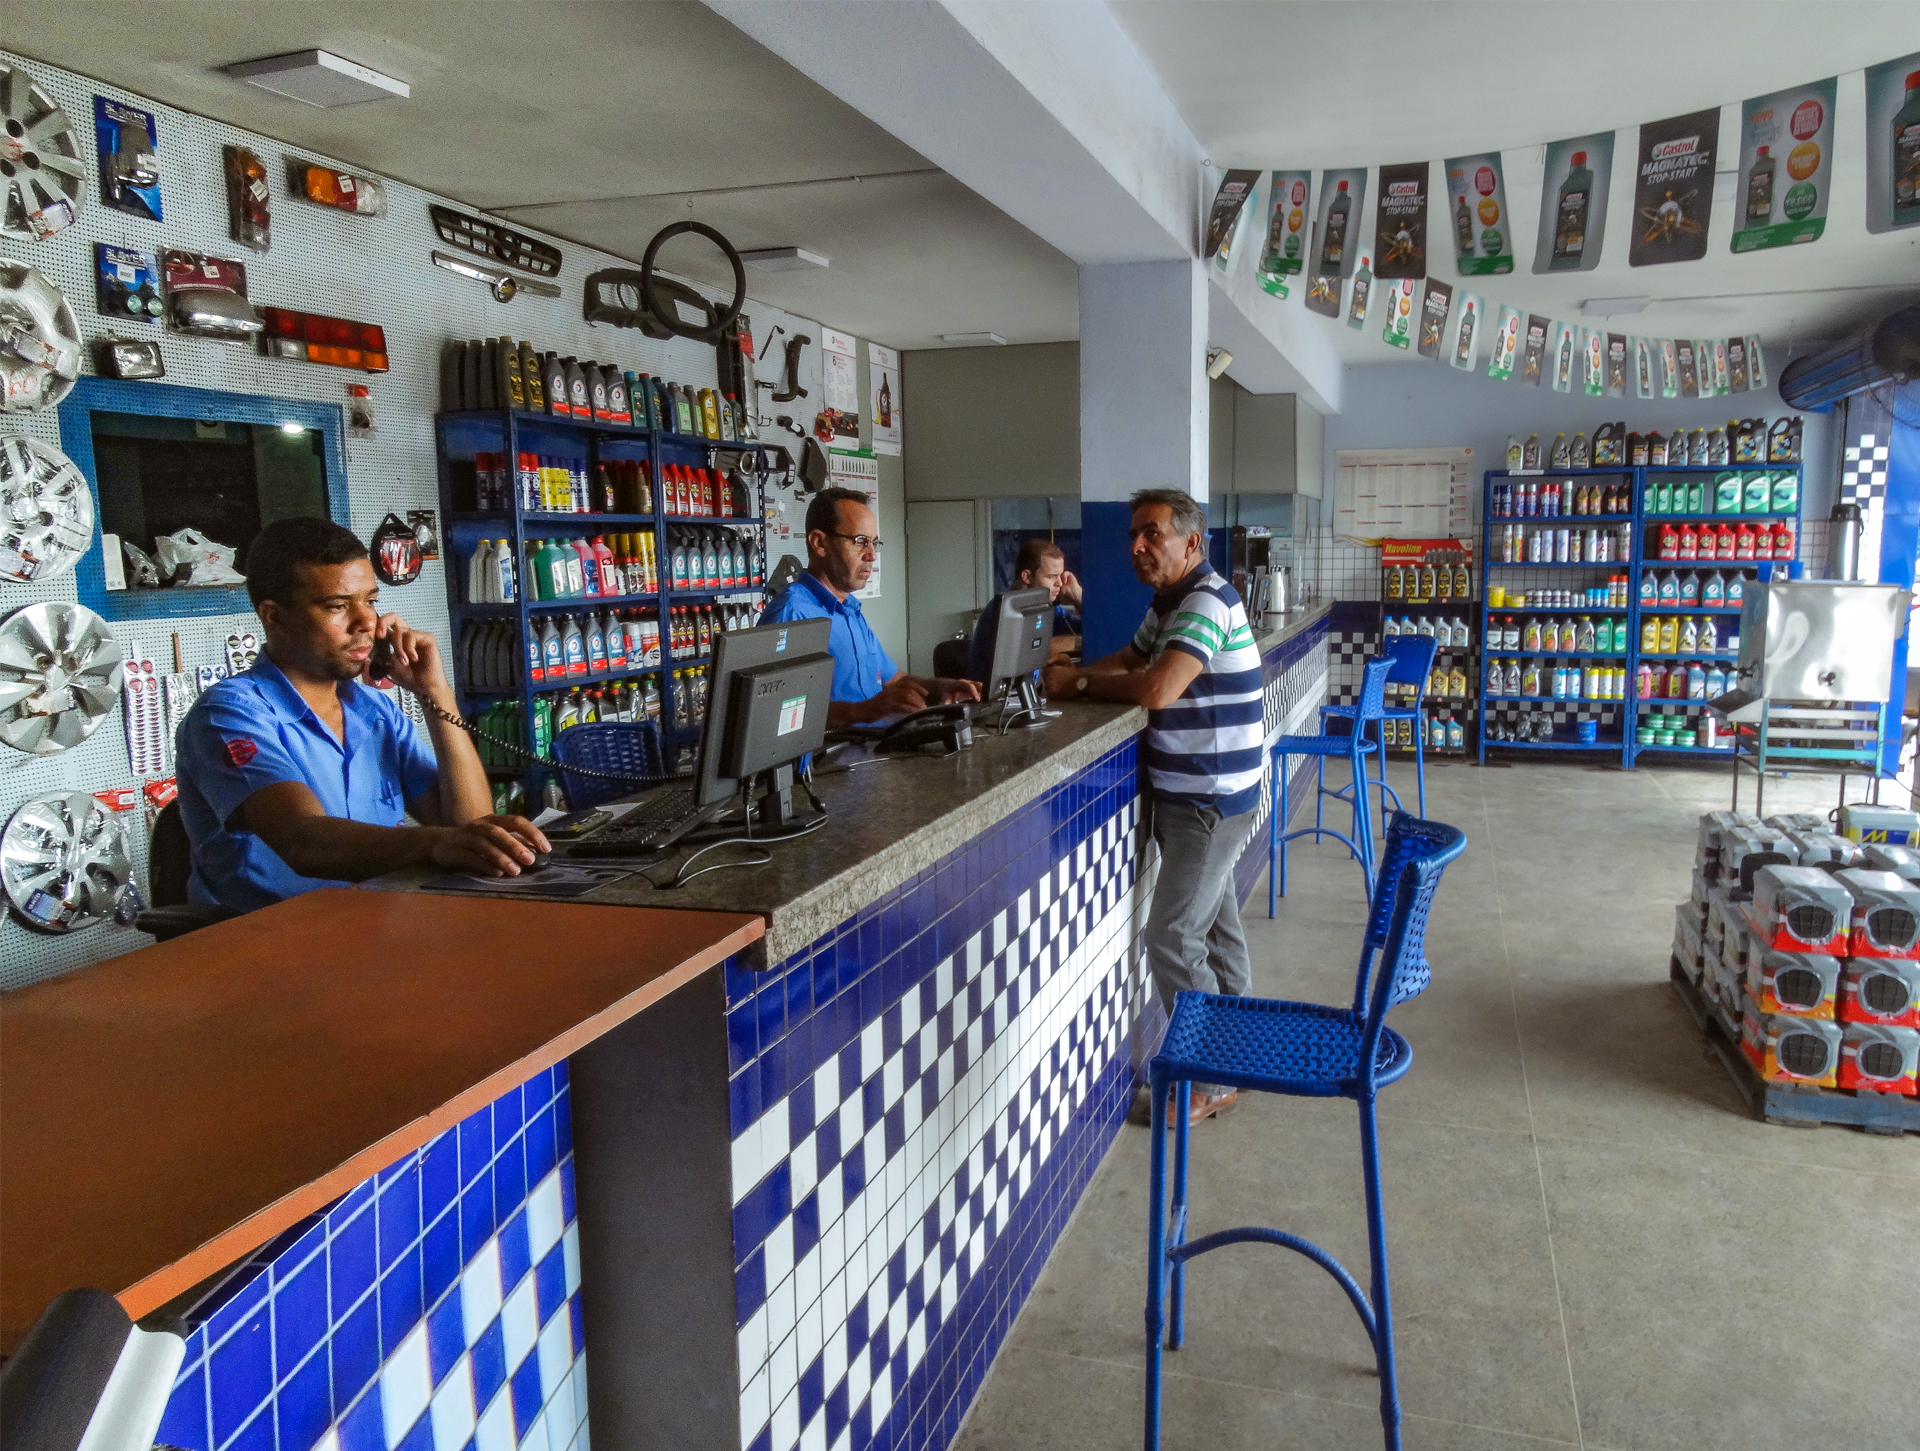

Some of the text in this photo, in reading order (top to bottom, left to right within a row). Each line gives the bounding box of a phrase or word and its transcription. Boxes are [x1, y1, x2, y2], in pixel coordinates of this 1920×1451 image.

[1662, 140, 1696, 157] Castrol
[1641, 151, 1710, 176] MAGNATEC
[1395, 184, 1416, 194] Castrol
[1385, 544, 1422, 554] Havoline
